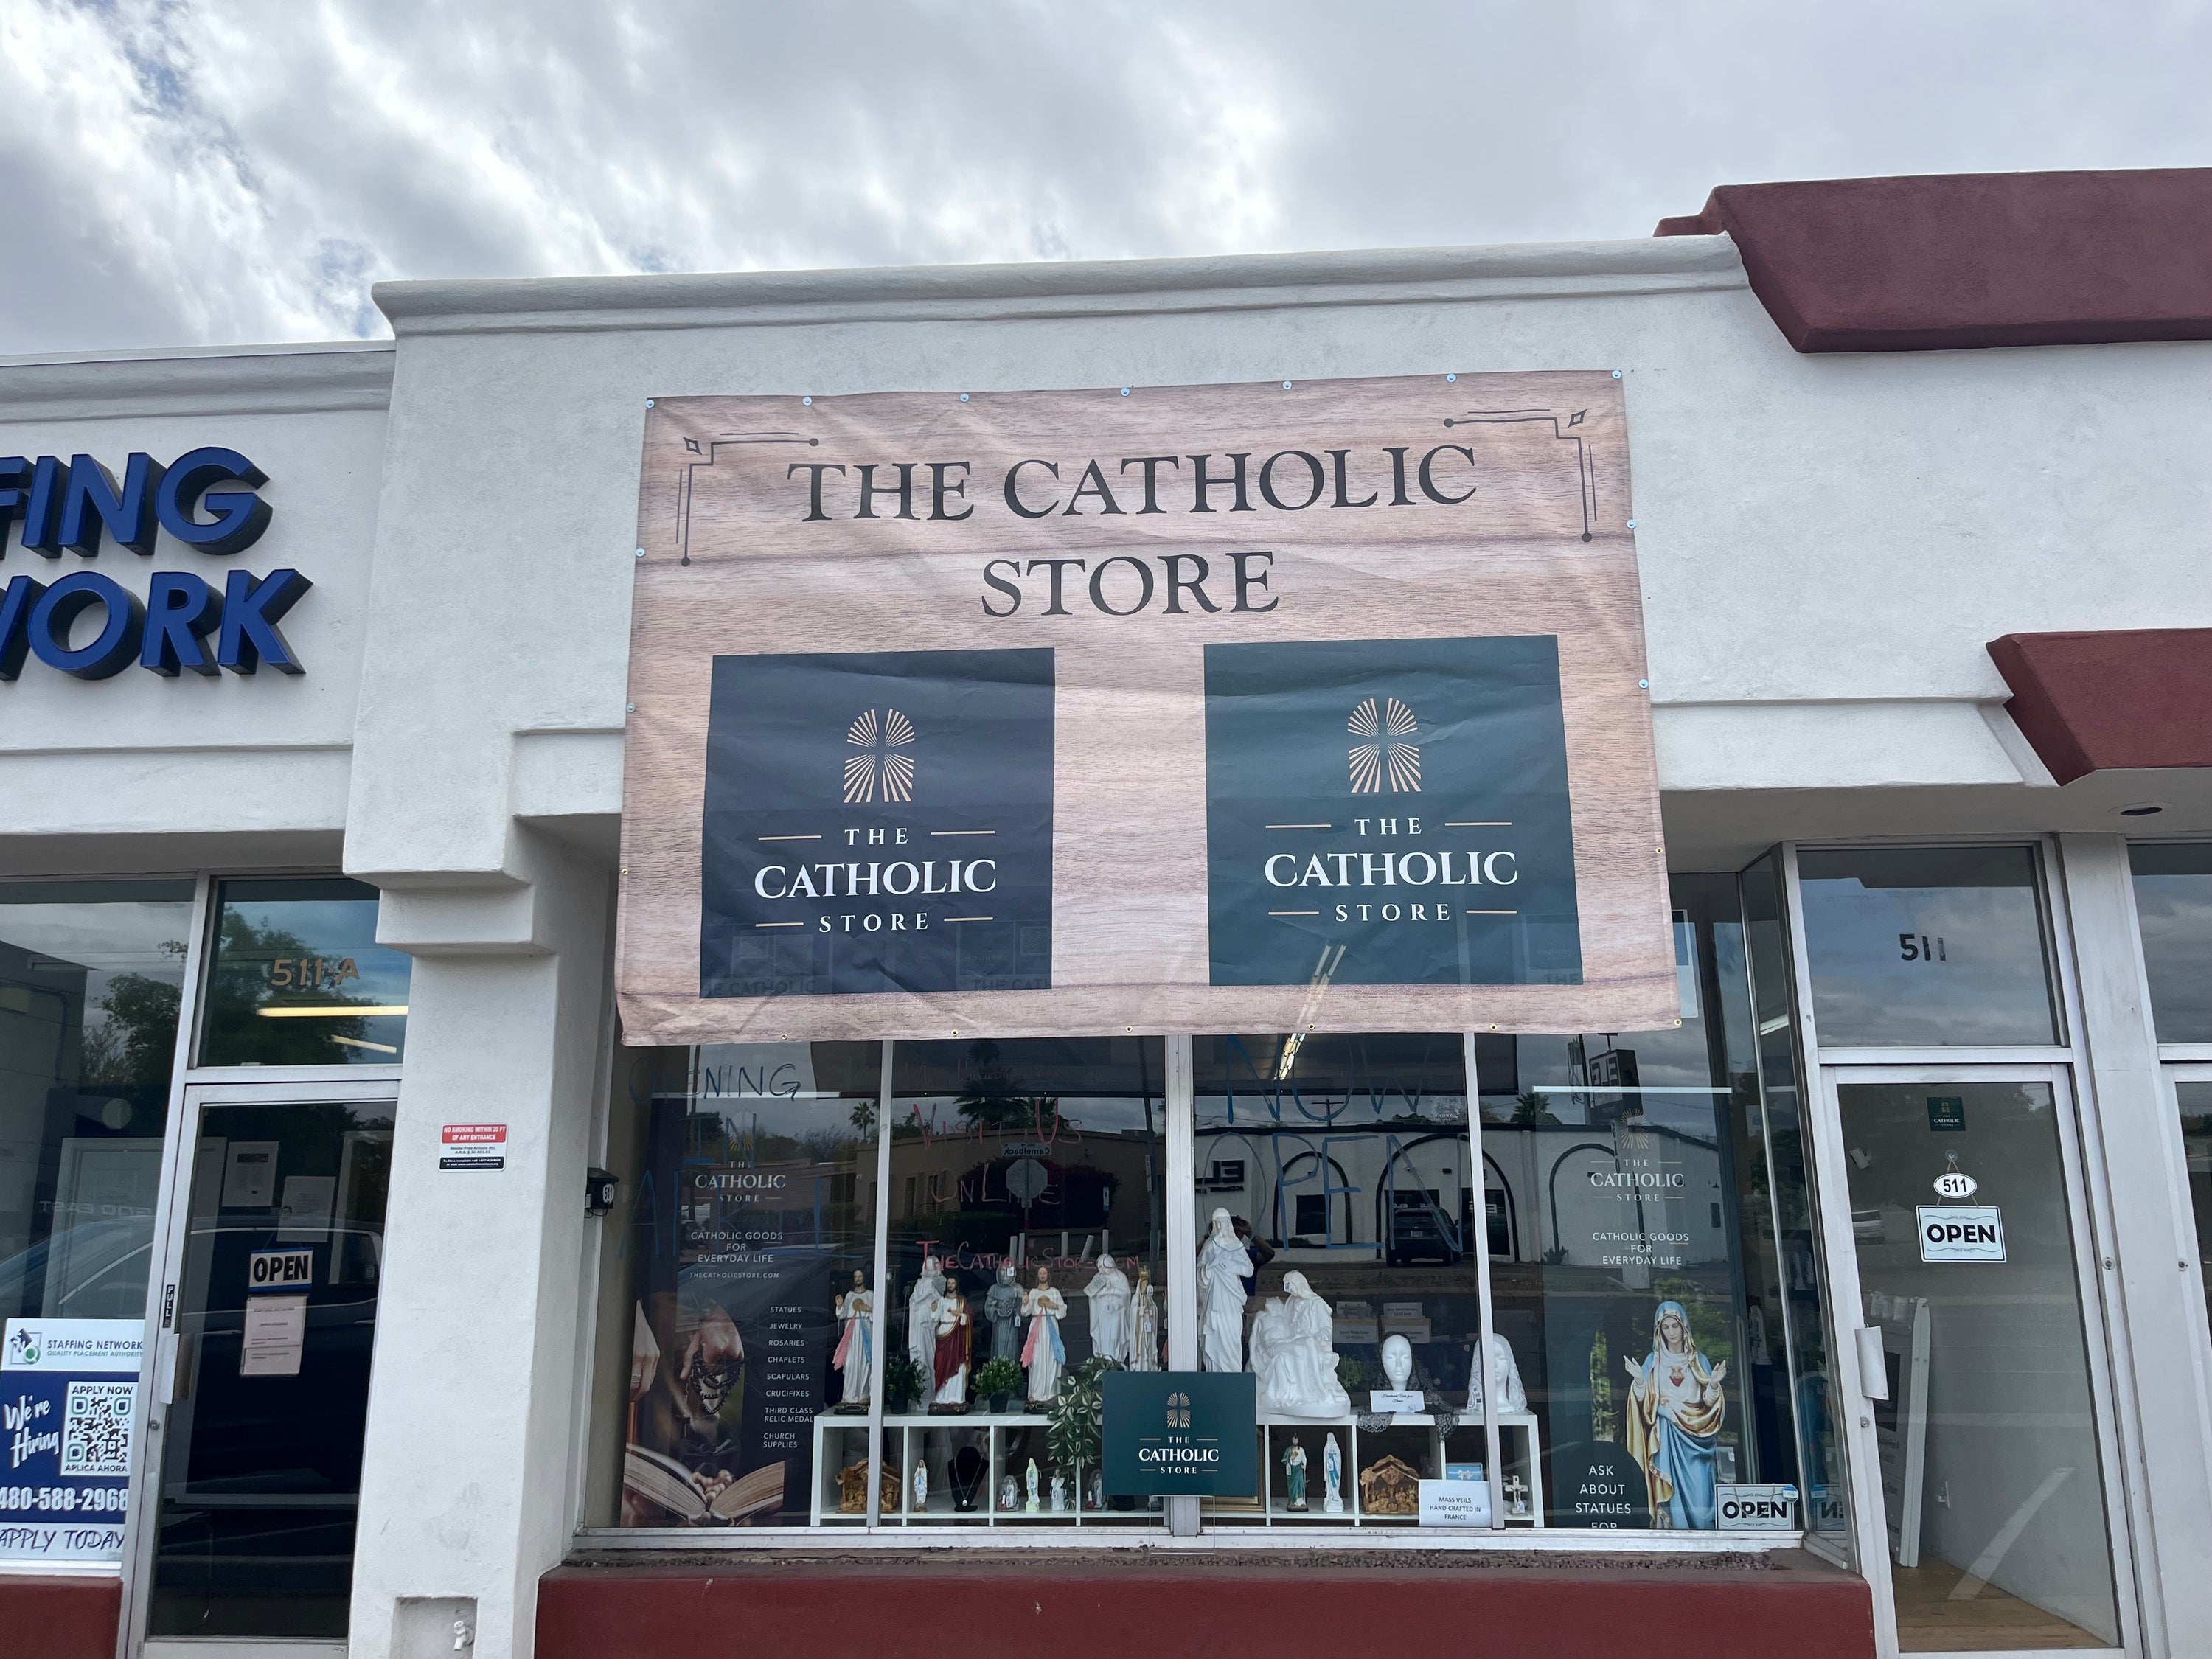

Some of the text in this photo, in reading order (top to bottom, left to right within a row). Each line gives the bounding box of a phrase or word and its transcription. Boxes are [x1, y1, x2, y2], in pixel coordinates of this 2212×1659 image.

[787, 445, 1477, 523] THE CATHOLIC
[981, 551, 1279, 618] STORE
[0, 568, 313, 681] ORK
[1354, 818, 1422, 835] THE
[844, 827, 909, 846] THE
[1265, 851, 1518, 887] CATHOLIC
[754, 859, 997, 900] CATHOLIC
[1335, 903, 1451, 922] STORE
[819, 912, 929, 933] STORE
[1899, 933, 1947, 961] 511
[271, 957, 360, 987] 511-A
[1034, 1099, 1082, 1145] US
[695, 1174, 785, 1189] CATHOLIC
[1590, 1172, 1684, 1188] CATHOLIC
[1943, 1178, 1967, 1192] 511
[719, 1194, 759, 1203] STORE
[1616, 1194, 1660, 1202] STORE
[691, 1231, 783, 1240] CATHOLIC GOODS
[1592, 1232, 1689, 1242] CATHOLIC GOODS
[1927, 1223, 1997, 1243] OPEN
[726, 1243, 747, 1251] FOR
[1630, 1245, 1652, 1253] FOR
[698, 1254, 773, 1263] EVERYDAY LIFE
[1602, 1256, 1682, 1265] EVERYDAY LIFE
[254, 1255, 309, 1283] OPEN
[166, 1286, 174, 1317] PULL
[47, 1340, 142, 1349] STAFFING NETWORK
[72, 1385, 133, 1394] APPLY NOW
[4, 1394, 51, 1430] We're
[10, 1427, 60, 1469] Hiring
[1138, 1448, 1220, 1462] CATHOLIC
[1588, 1465, 1614, 1475] ASK
[0, 1486, 129, 1511] 480-588-2968
[1579, 1484, 1625, 1495] ABOUT
[1575, 1503, 1631, 1514] STATUES
[1722, 1500, 1787, 1519] OPEN
[0, 1528, 125, 1553] APPLY TODAY
